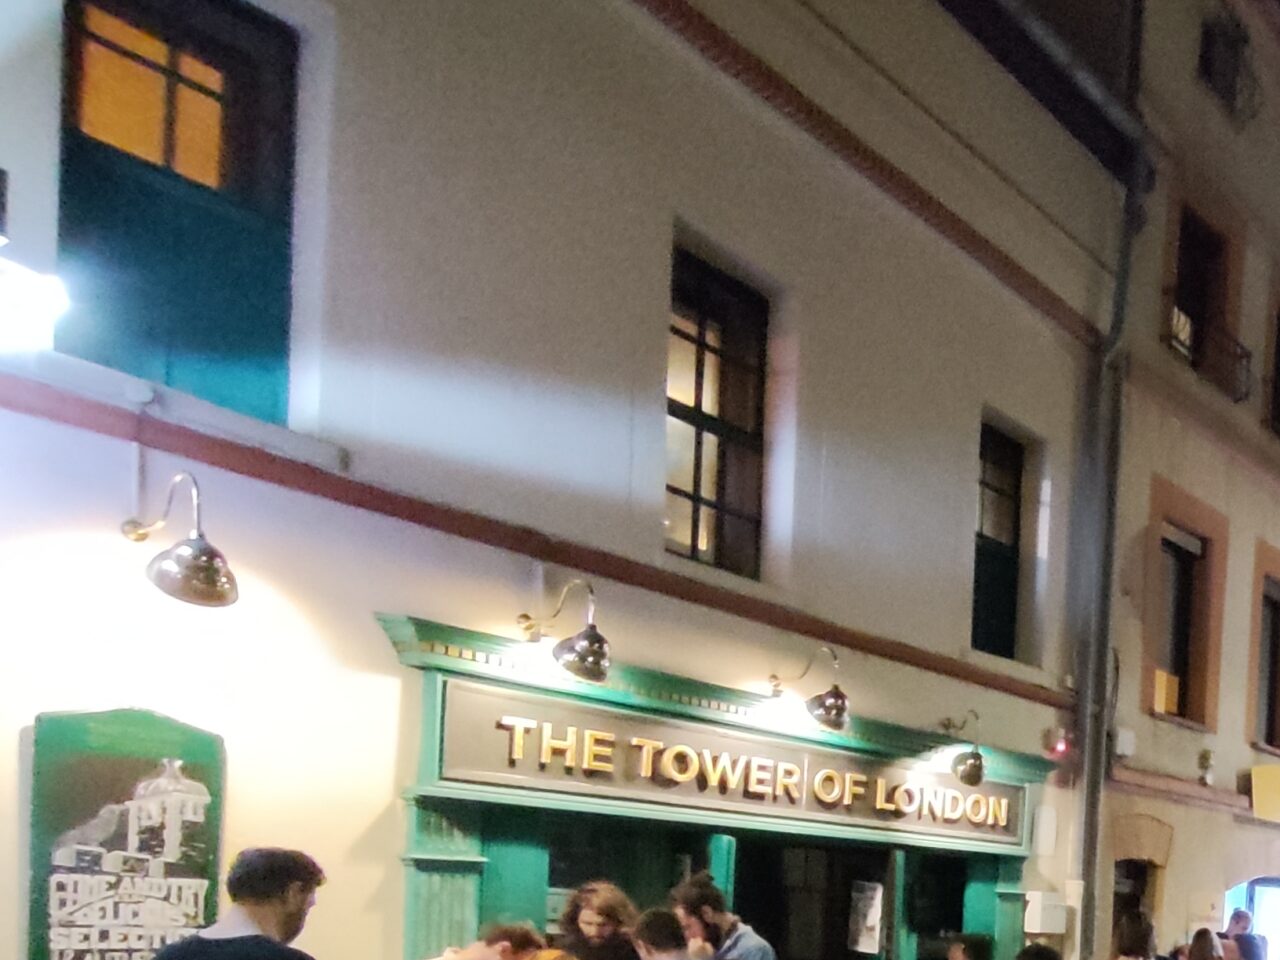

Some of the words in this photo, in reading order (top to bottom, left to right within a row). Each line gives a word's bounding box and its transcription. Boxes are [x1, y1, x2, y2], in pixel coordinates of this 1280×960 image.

[500, 715, 616, 773] THE
[631, 736, 801, 799] TOWER
[812, 768, 868, 806] OF
[875, 777, 1009, 827] LONDON
[49, 926, 194, 950] SELECTI
